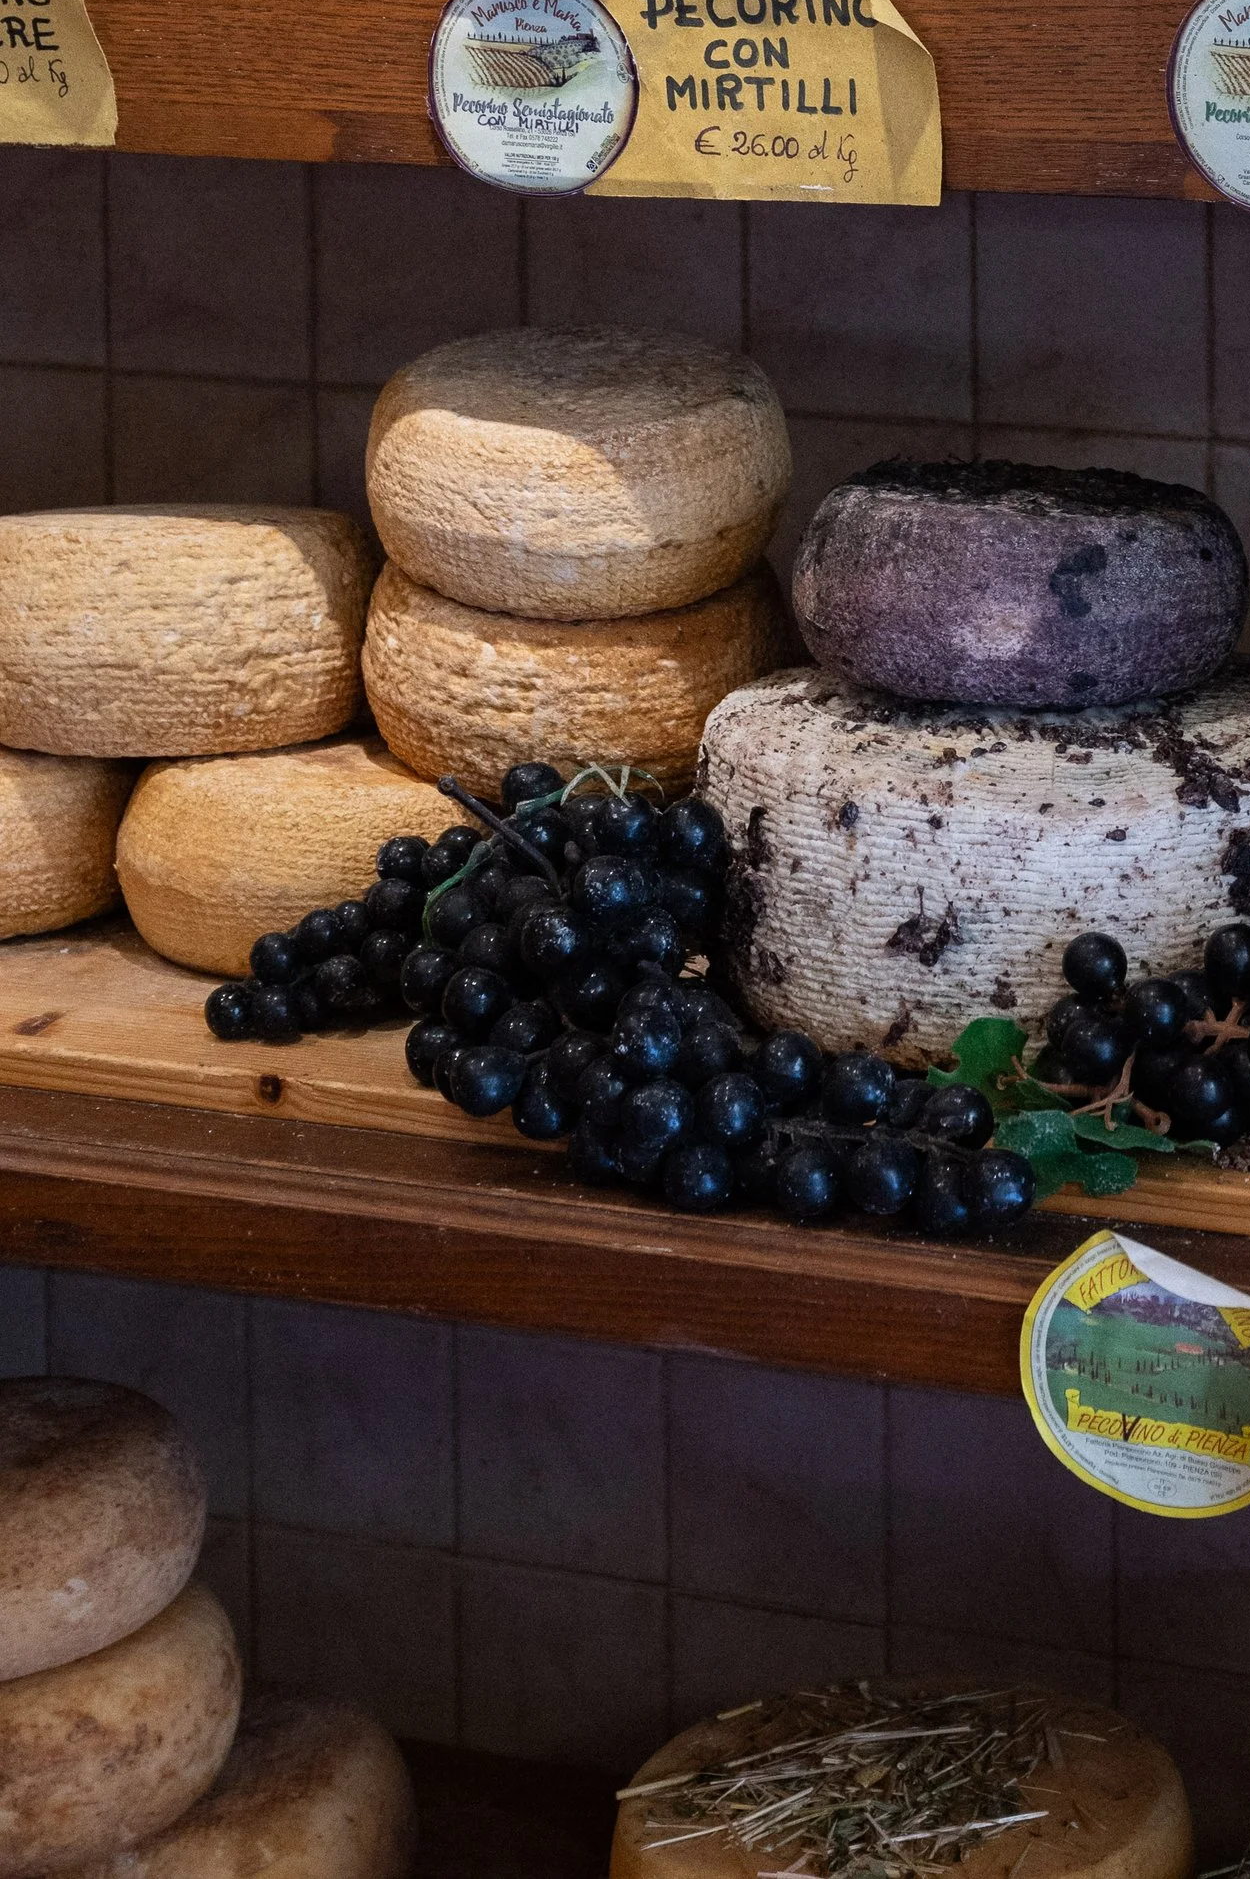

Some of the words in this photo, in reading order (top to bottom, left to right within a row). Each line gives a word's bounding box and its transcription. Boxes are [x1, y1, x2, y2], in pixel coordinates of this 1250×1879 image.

[515, 17, 548, 33] Pienza
[532, 0, 540, 10] e
[544, 0, 582, 32] Maria
[703, 36, 791, 70] CON
[48, 58, 69, 98] Kg
[665, 72, 858, 116] MIRTILLI
[452, 92, 509, 116] Pecorino
[512, 97, 615, 124] Semistagionato
[477, 113, 506, 127] CON
[1236, 133, 1250, 141] Corso
[694, 125, 721, 156] €
[731, 131, 800, 158] 26.00
[836, 134, 859, 183] Kg
[1079, 1258, 1138, 1305] FATTO
[1168, 1432, 1179, 1444] di
[1185, 1429, 1248, 1460] PIENZA
